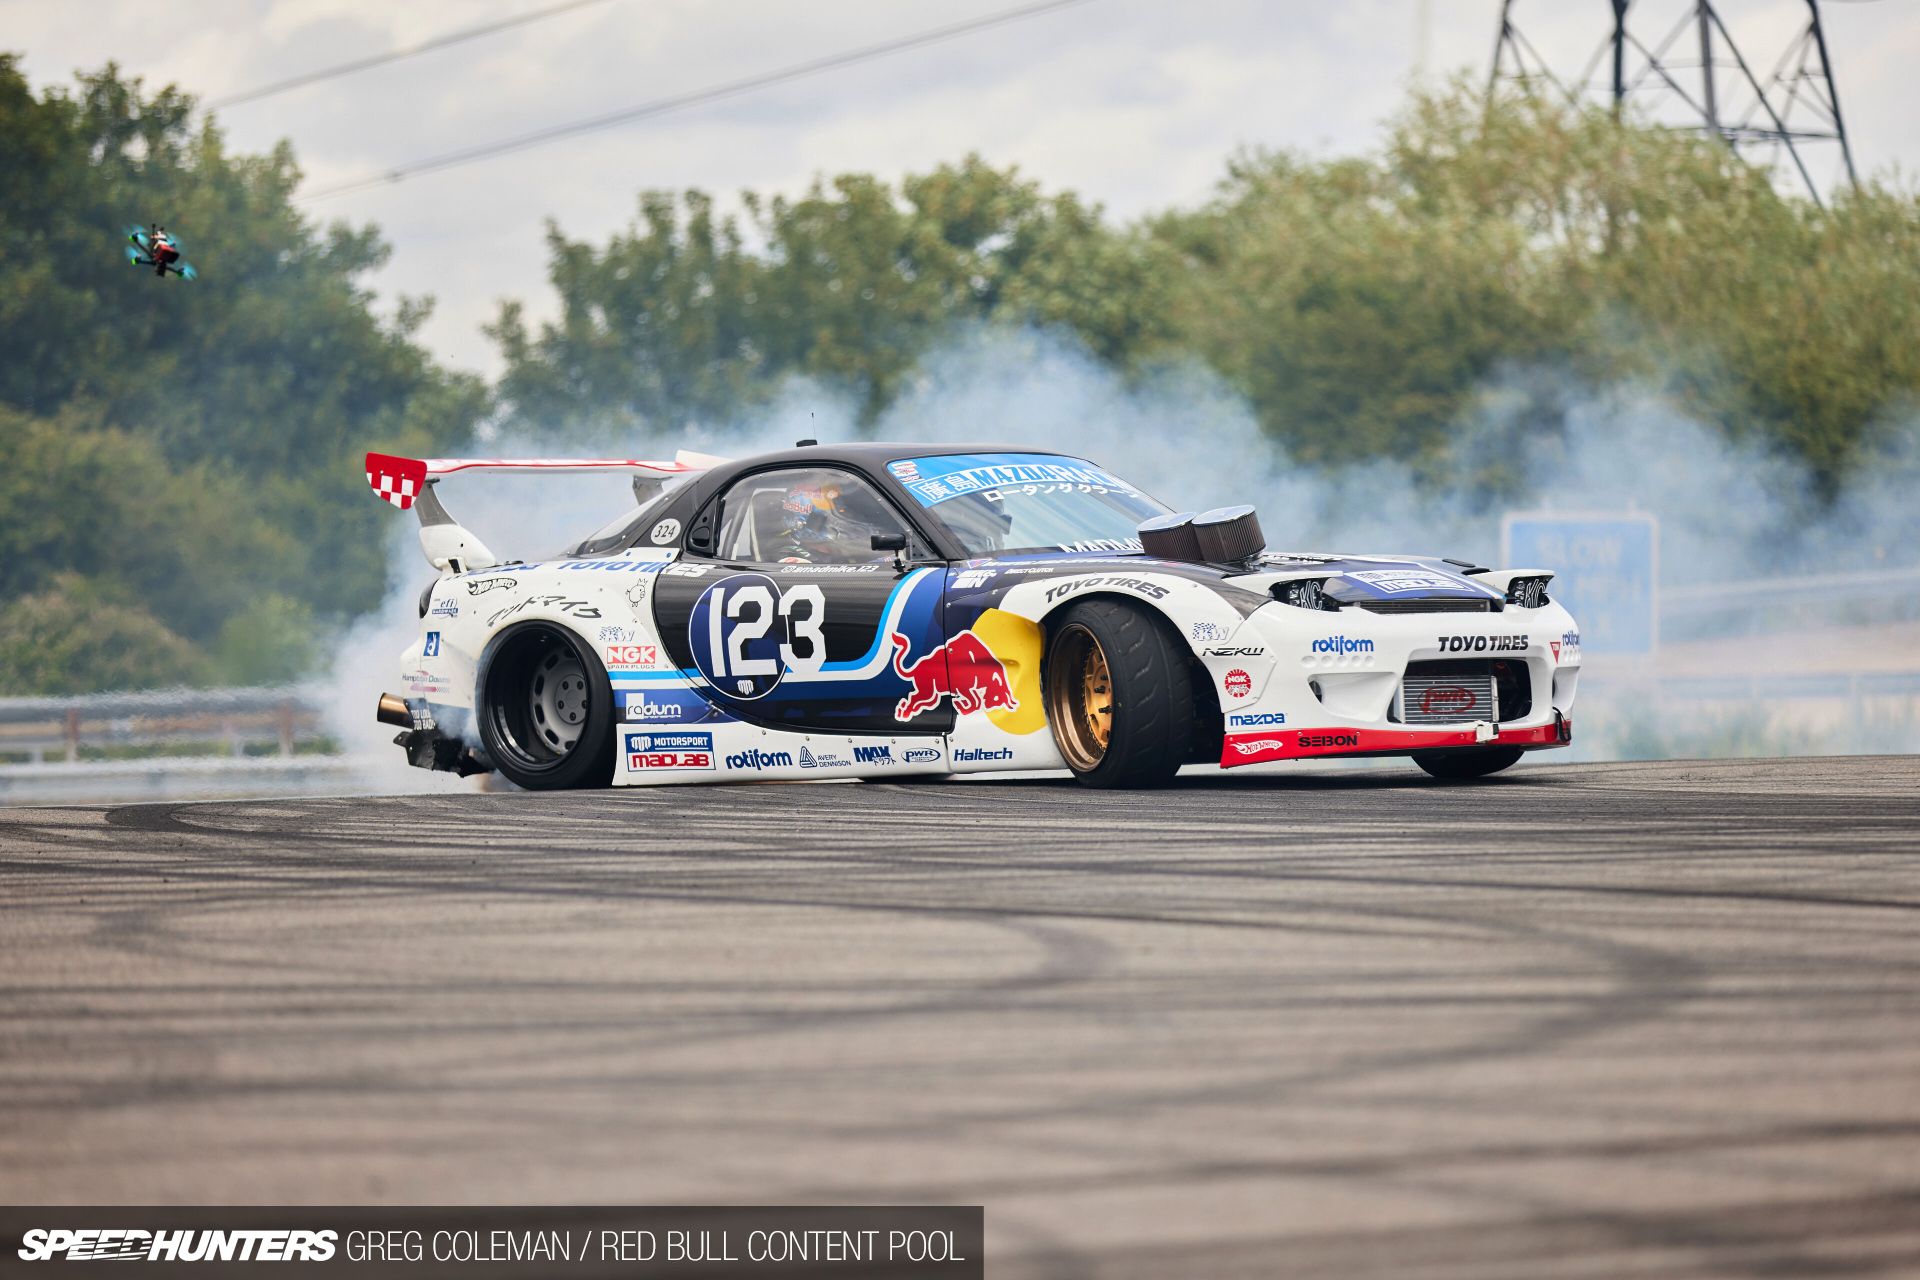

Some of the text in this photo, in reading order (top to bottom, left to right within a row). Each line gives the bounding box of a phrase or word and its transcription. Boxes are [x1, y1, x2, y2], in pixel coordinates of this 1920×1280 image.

[969, 466, 1058, 488] MAZDA
[793, 501, 812, 515] Bull
[654, 525, 676, 539] 324
[557, 562, 716, 578] TOYO TIRES
[1045, 577, 1170, 603] TOYO TIRES
[1300, 580, 1322, 609] KC
[709, 585, 826, 677] 123
[1196, 626, 1229, 641] KW
[1312, 635, 1374, 655] rotiform
[1438, 635, 1528, 651] TOYO TIRES
[607, 646, 655, 663] NGK
[402, 673, 451, 683] Hampton Downs
[1227, 675, 1247, 683] NGK
[627, 701, 682, 715] radium
[1230, 713, 1286, 726] mazda
[654, 736, 709, 746] MOTORSPORT
[726, 748, 793, 771] rotiform
[853, 746, 891, 763] MAX
[954, 747, 1013, 762] Haltech
[819, 760, 852, 768] DENNISON
